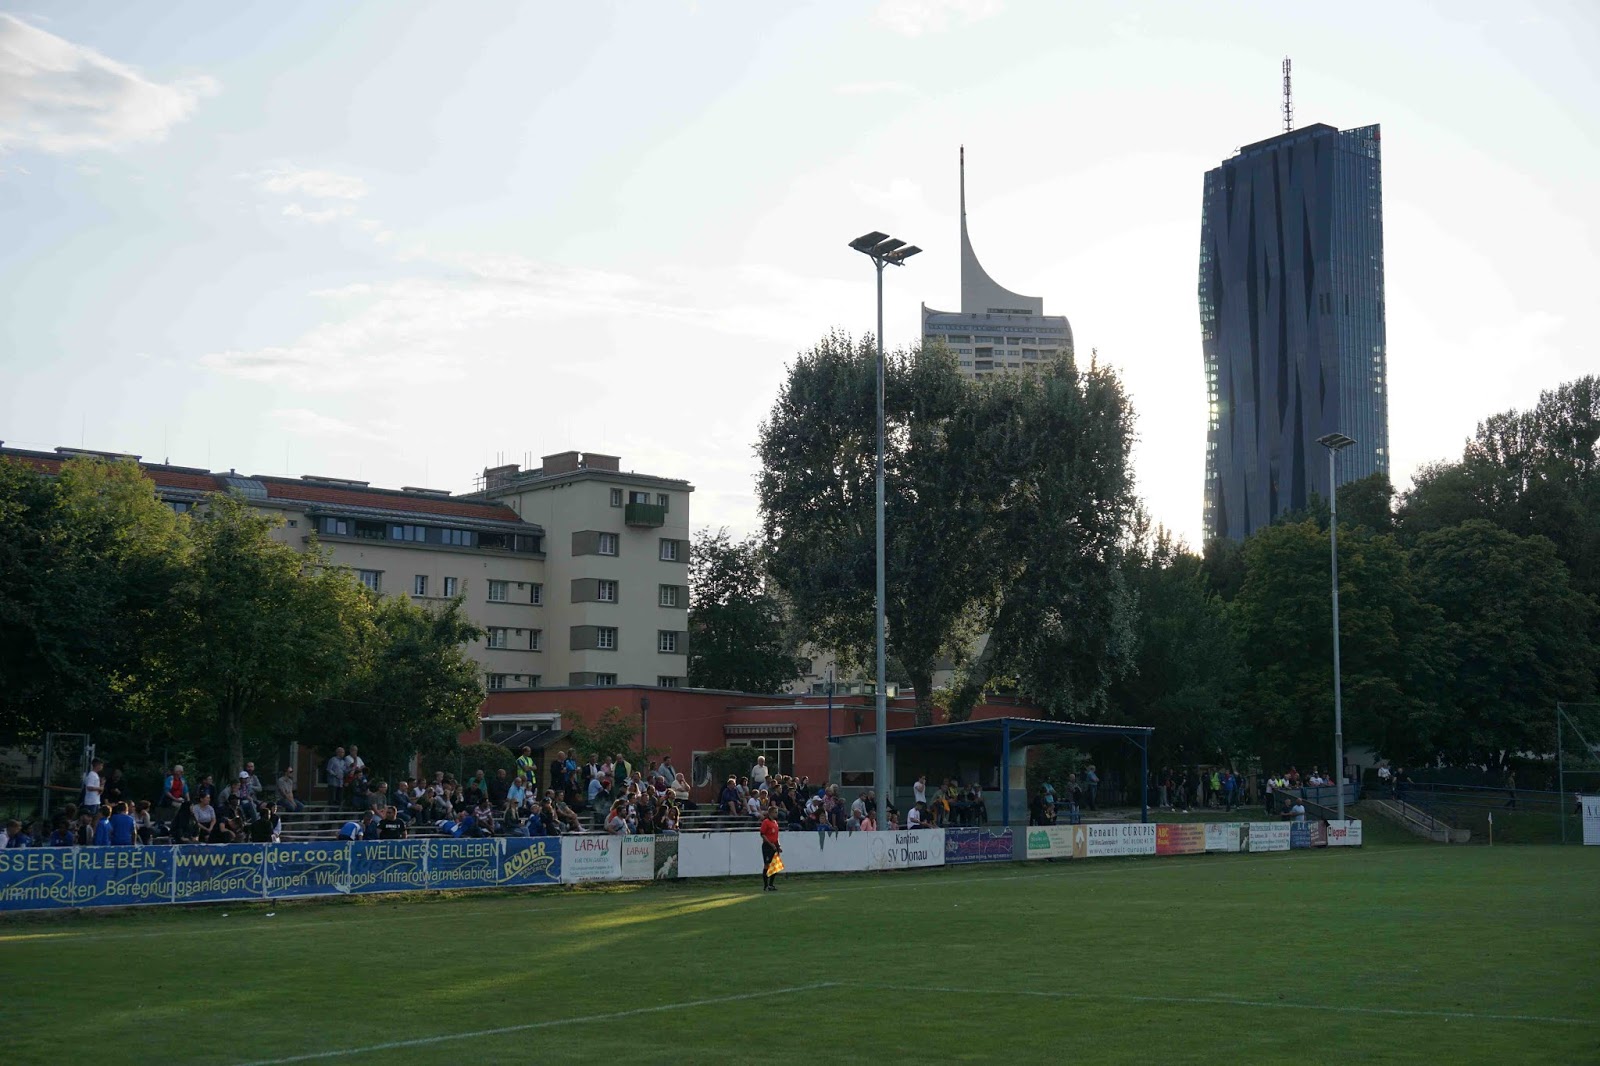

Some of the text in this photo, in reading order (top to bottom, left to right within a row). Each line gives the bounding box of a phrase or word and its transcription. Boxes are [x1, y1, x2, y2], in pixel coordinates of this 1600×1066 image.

[1089, 826, 1155, 837] Renault CURUPIS
[633, 835, 654, 843] Garten
[896, 833, 919, 845] Kantine
[0, 853, 55, 872] SSER
[62, 851, 156, 870] ERLEBEN
[175, 846, 350, 867] www.roeder.co.at
[365, 844, 438, 861] WELLNESS
[442, 843, 498, 859] ERLEBEN
[888, 848, 928, 862] SV Donau
[106, 876, 245, 898] Beregnungsanlagen
[253, 874, 308, 890] Pumpen
[315, 870, 376, 888] Whirlpools
[383, 866, 497, 883] Infrarotwärmekabinen
